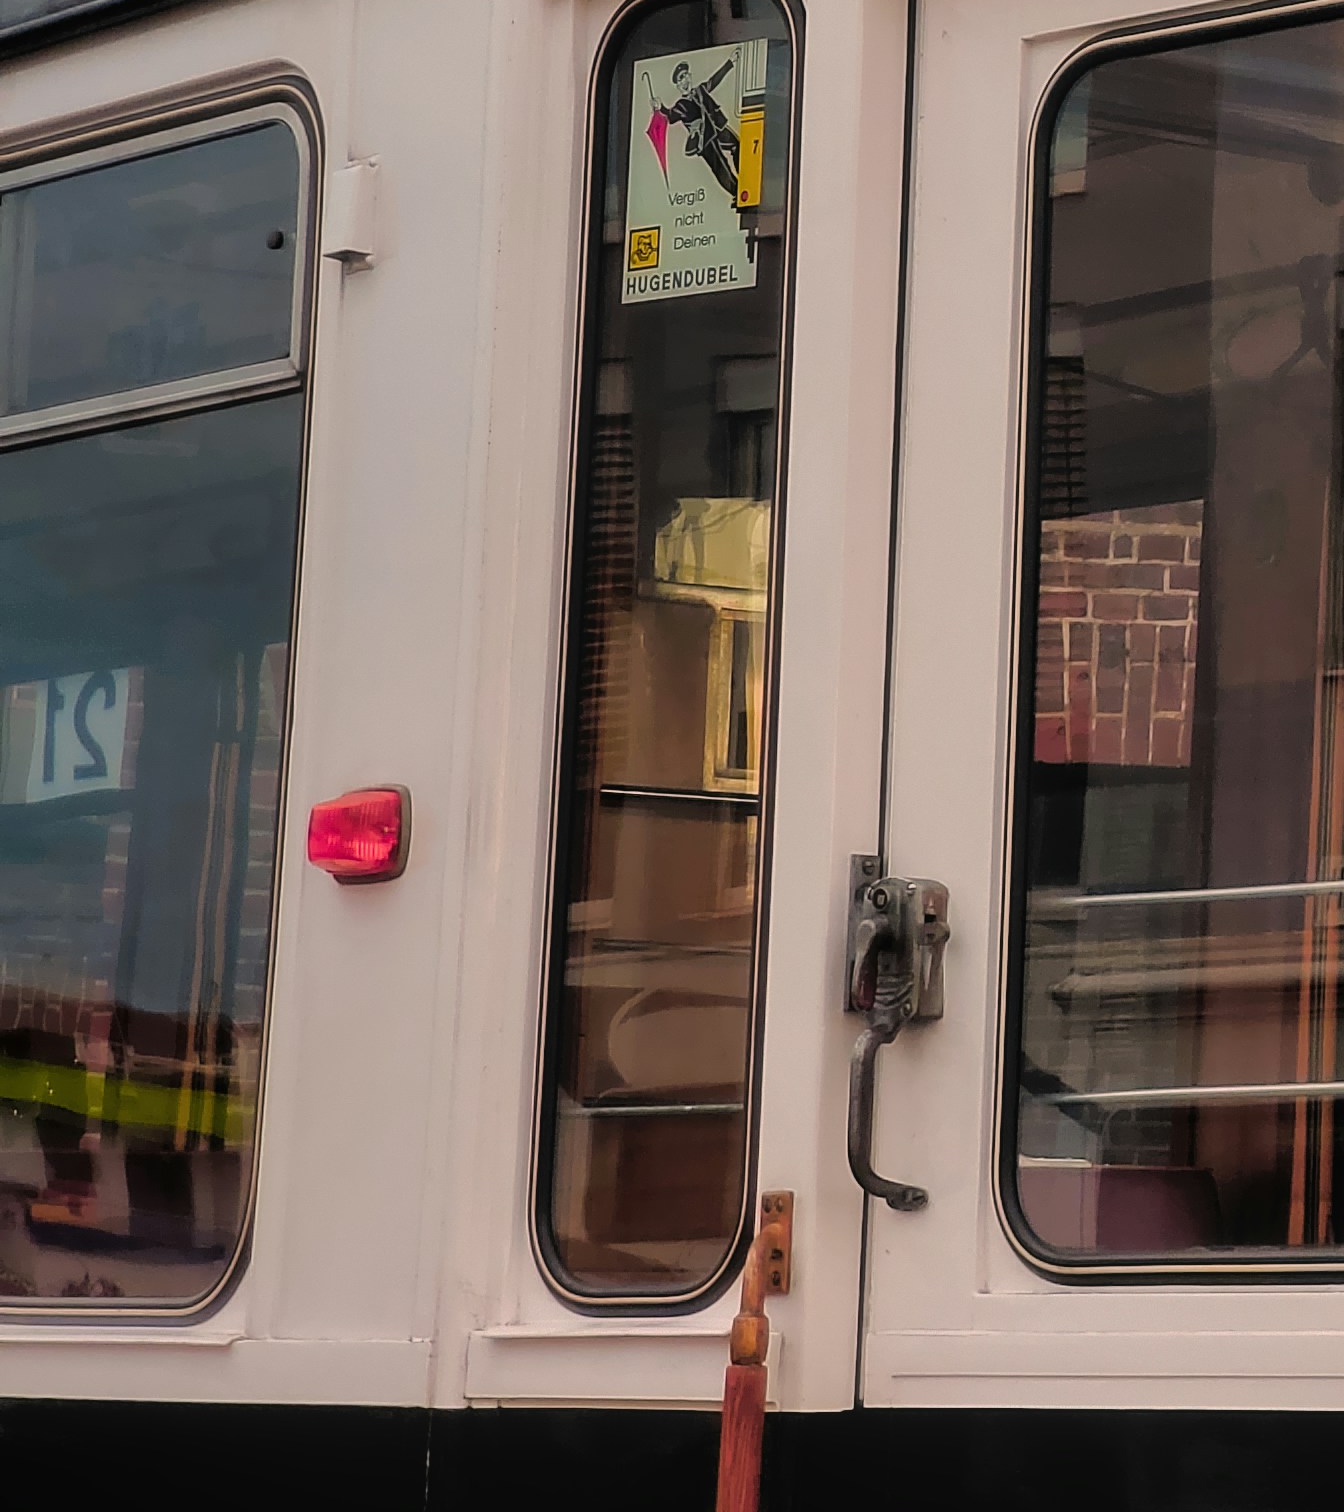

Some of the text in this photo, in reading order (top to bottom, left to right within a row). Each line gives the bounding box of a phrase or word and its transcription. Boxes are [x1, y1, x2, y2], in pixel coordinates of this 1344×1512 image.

[668, 188, 706, 206] Vergiß
[675, 211, 704, 228] nicht
[673, 234, 716, 251] Deinen
[626, 264, 739, 296] HUGENDUBEL
